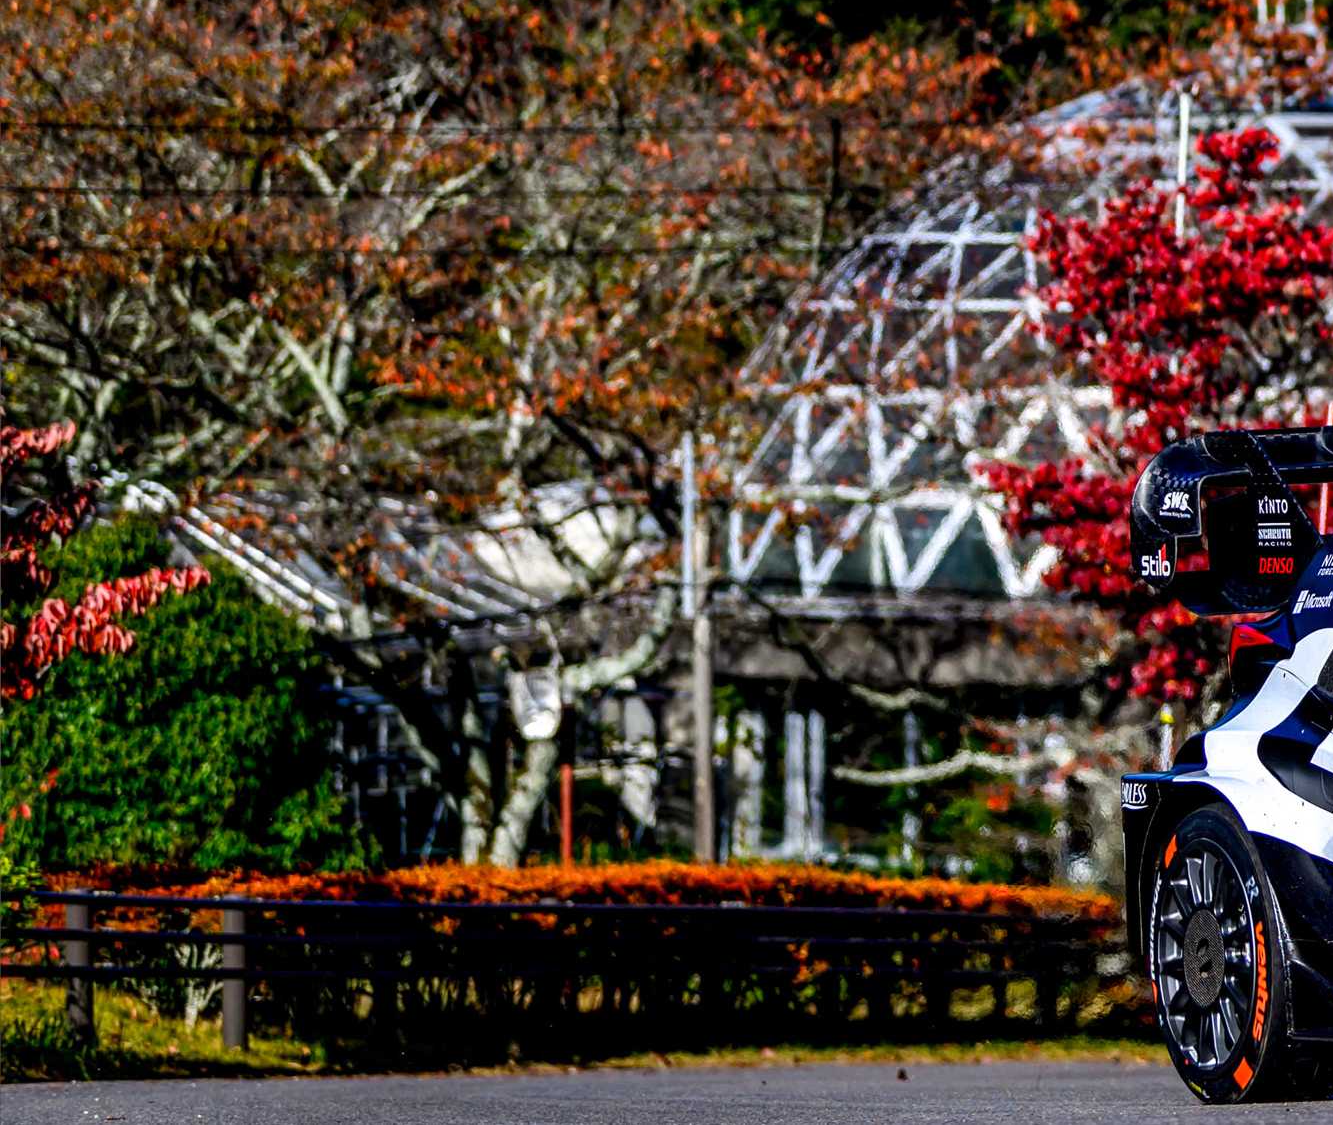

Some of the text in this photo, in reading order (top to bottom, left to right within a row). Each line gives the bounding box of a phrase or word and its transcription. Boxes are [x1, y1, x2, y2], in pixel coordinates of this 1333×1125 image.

[1161, 491, 1191, 511] SWS
[1141, 546, 1171, 577] Stilo
[1258, 556, 1294, 575] DENSO
[1303, 591, 1333, 608] Microsoft
